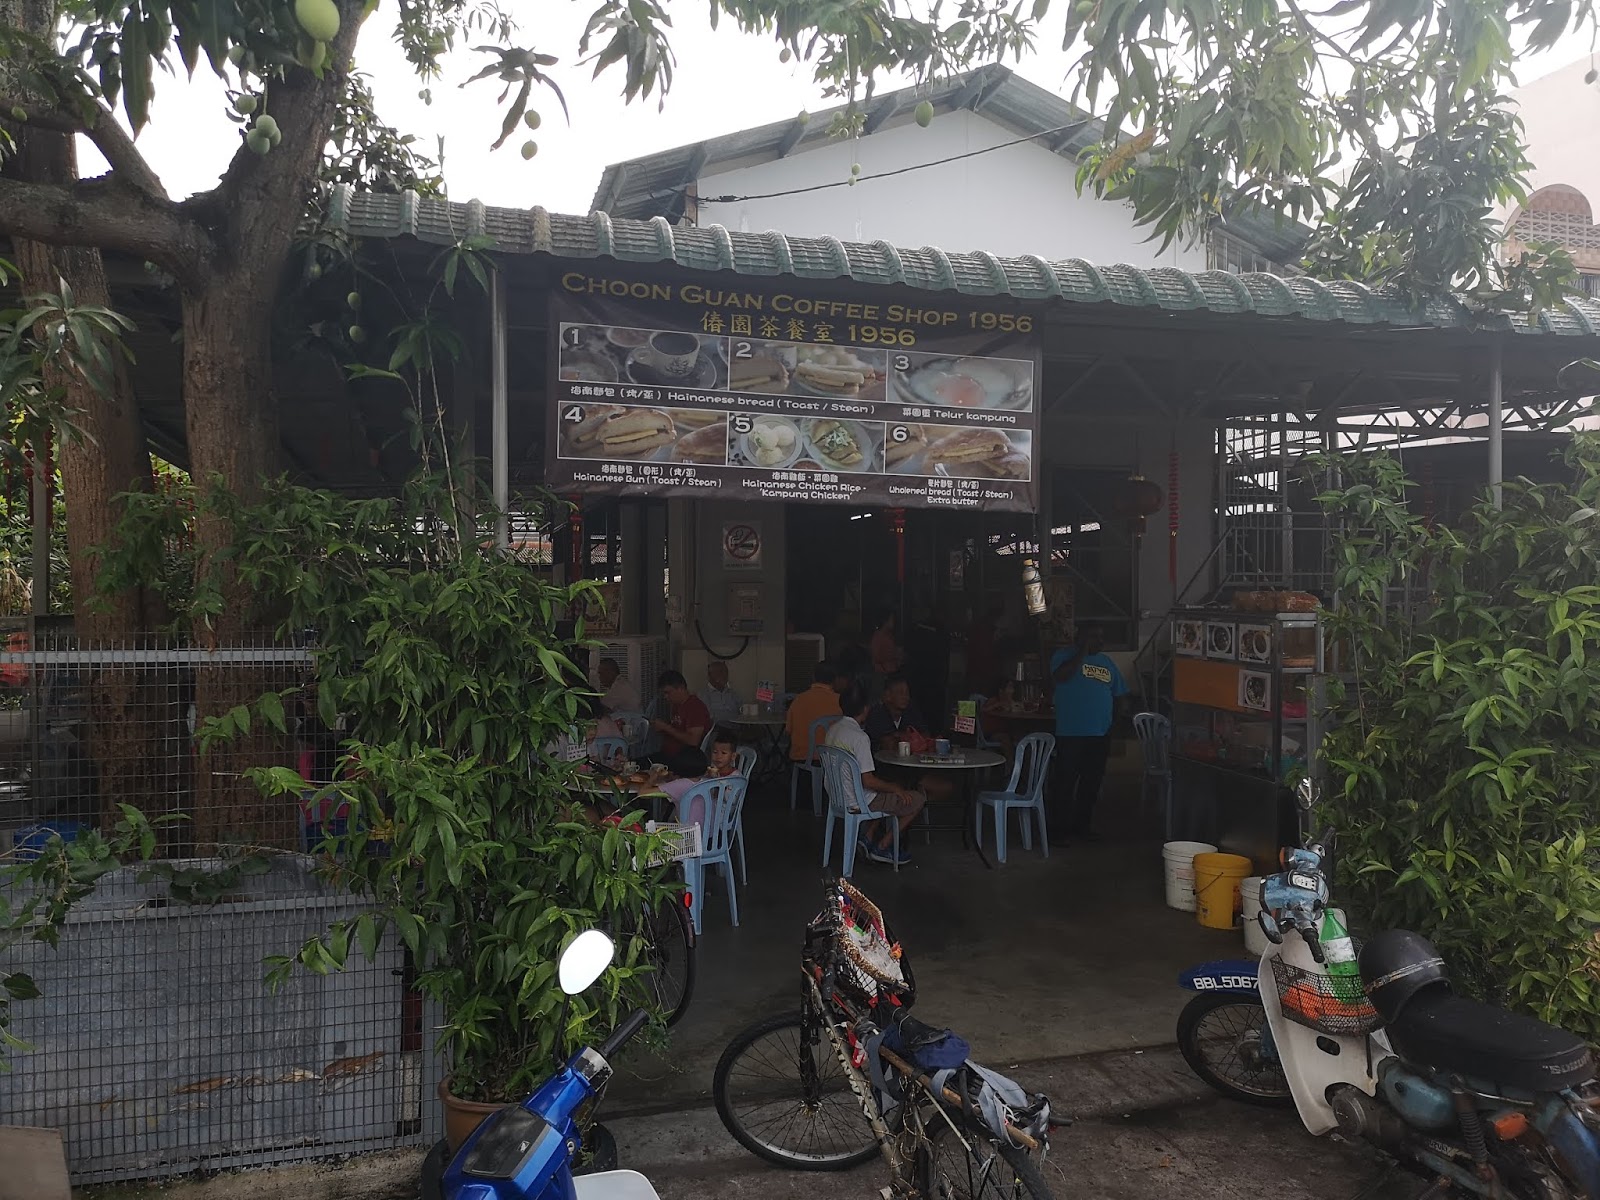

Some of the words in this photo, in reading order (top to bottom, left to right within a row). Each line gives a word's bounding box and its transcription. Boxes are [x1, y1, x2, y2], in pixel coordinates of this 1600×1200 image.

[561, 272, 671, 301] CHOON
[680, 285, 763, 310] GUAN
[771, 294, 880, 321] COFFEE
[887, 305, 958, 326] SHOP
[969, 311, 1033, 333] 1956
[571, 328, 579, 345] 1
[849, 324, 916, 346] 1956
[735, 342, 753, 358] 2
[894, 355, 910, 371] 3
[667, 391, 735, 405] Hainanese
[737, 396, 775, 408] bread
[564, 406, 583, 423] 4
[933, 409, 964, 420] Telur
[966, 412, 1016, 424] kampung
[734, 416, 751, 433] 5
[893, 426, 908, 442] 6
[573, 472, 624, 483] Hainanese
[742, 479, 796, 489] Hainanese
[798, 482, 838, 491] Chicken
[840, 483, 861, 492] Rice
[928, 488, 952, 496] bread
[927, 496, 951, 505] Extra
[952, 497, 979, 506] butter
